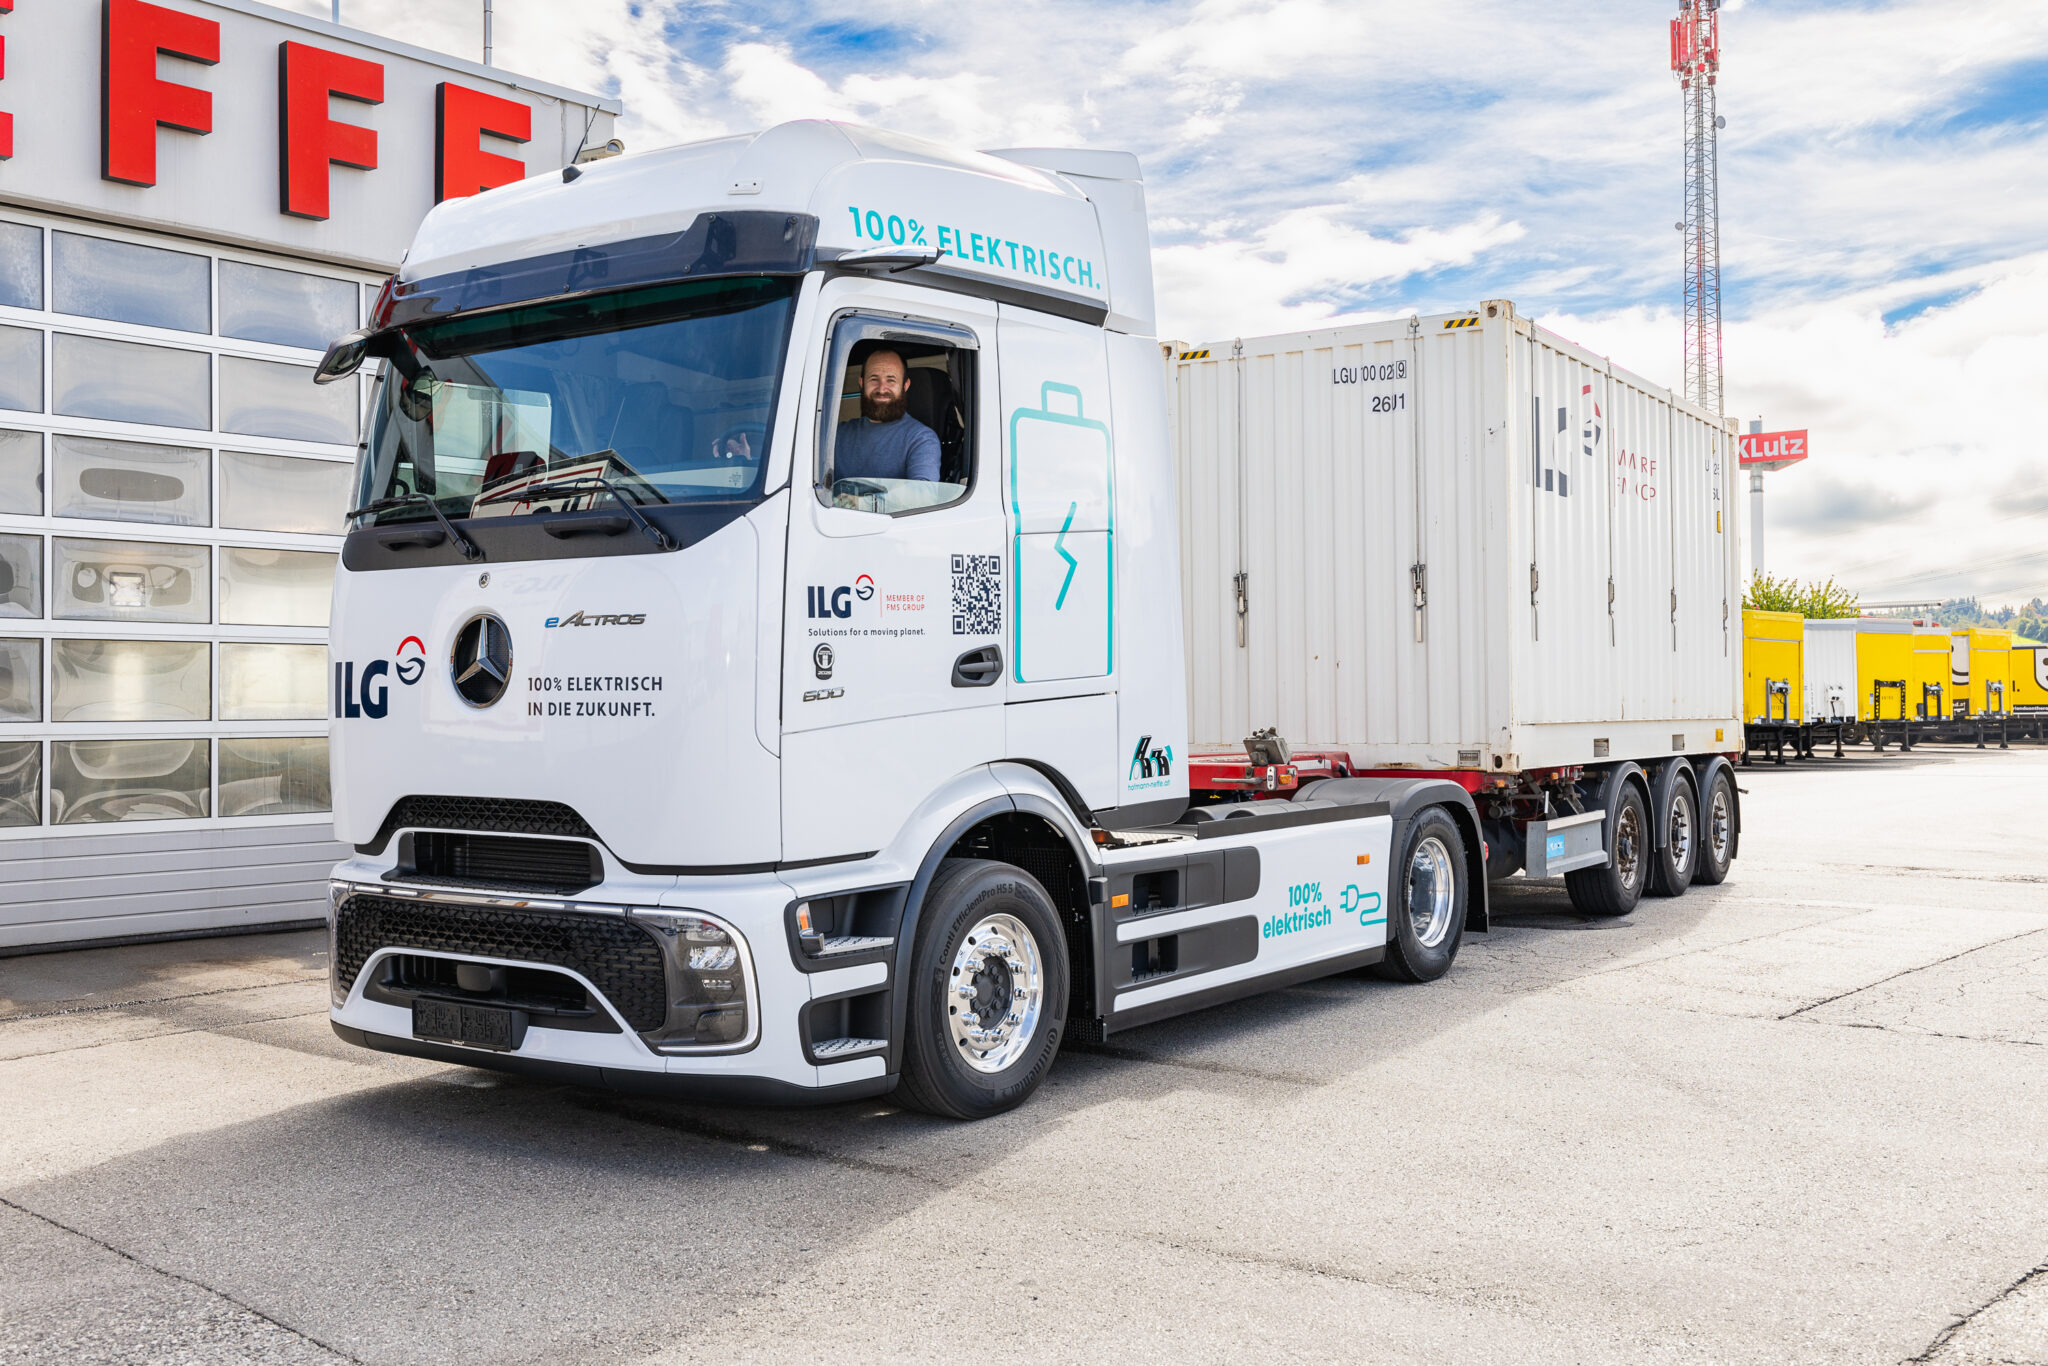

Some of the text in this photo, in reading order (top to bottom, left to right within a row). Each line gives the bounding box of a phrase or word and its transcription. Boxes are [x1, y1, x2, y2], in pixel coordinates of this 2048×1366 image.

[848, 206, 1100, 290] 100% ELEKTRISCH.
[807, 586, 852, 619] ILG
[886, 594, 914, 602] MEMBER
[886, 603, 925, 611] FMS GROUP
[808, 628, 848, 637] Solutions
[850, 627, 860, 636] for
[870, 628, 898, 638] moving
[900, 628, 926, 637] planet.
[335, 659, 389, 719] ILG
[528, 676, 663, 692] 100% ELEKTRISCH
[528, 701, 656, 717] IN DIE ZUKUNFT.
[1288, 881, 1323, 908] 100%
[1263, 906, 1332, 938] elektrisch
